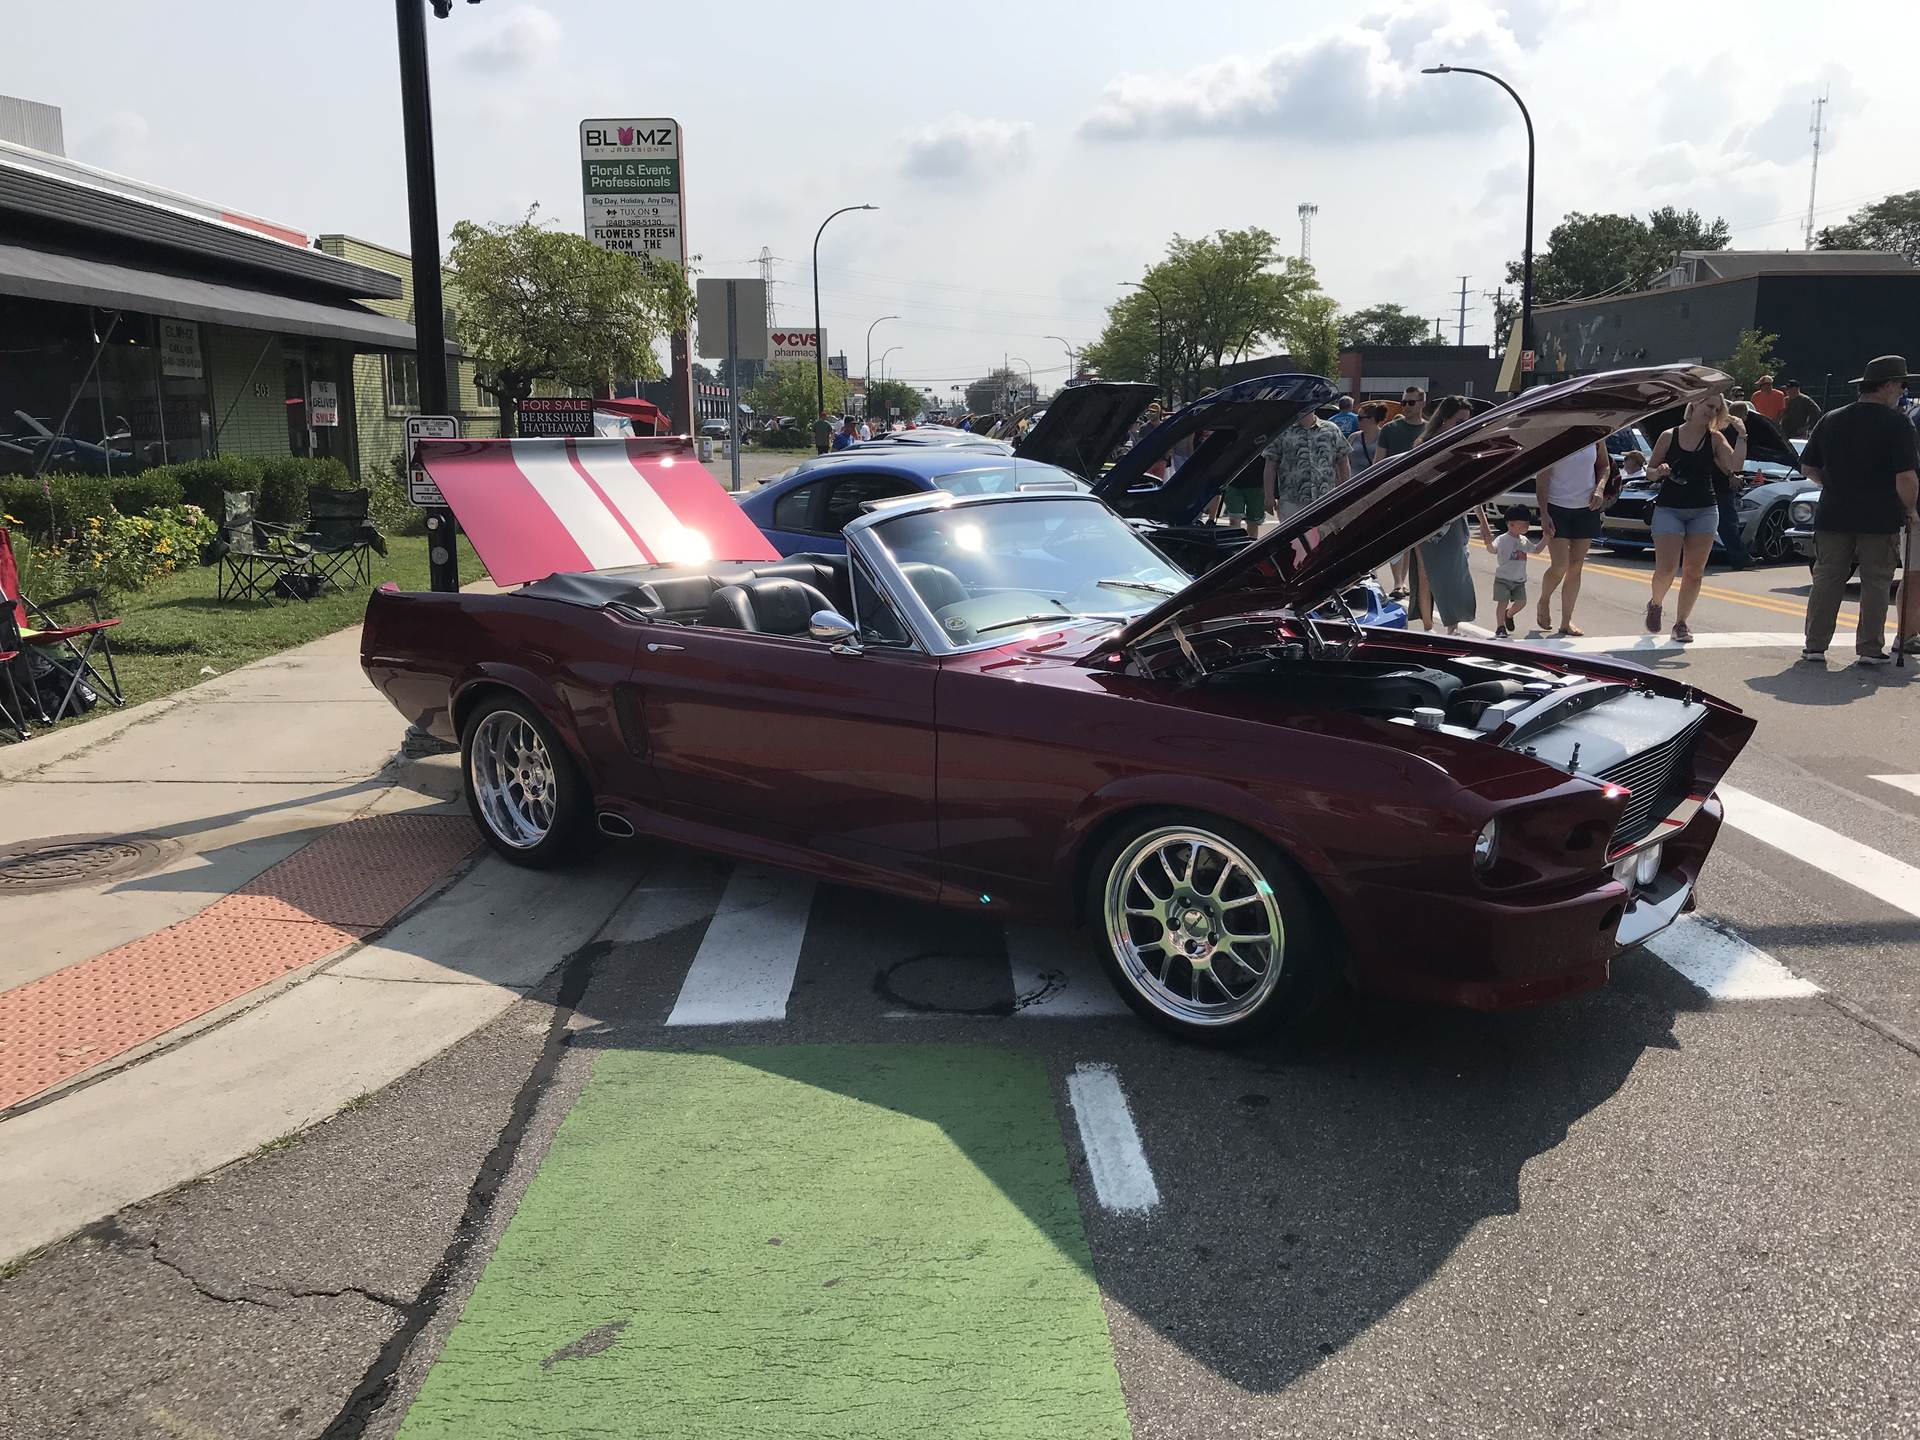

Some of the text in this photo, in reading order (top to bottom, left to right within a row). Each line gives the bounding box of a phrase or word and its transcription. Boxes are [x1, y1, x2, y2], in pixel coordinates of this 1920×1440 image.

[589, 164, 672, 176] Floral & Event
[591, 176, 671, 187] Professionals
[592, 197, 603, 206] Big
[647, 197, 660, 205] Any
[620, 208, 659, 216] TUX ON 9
[594, 228, 675, 239] FLOWERS FRESH
[605, 239, 662, 250] FROM THE
[787, 333, 817, 346] CVS
[774, 348, 818, 359] pharmacy
[255, 383, 270, 397] 503
[522, 400, 589, 411] FOR SALE
[520, 412, 591, 423] BERKSHIRE
[523, 423, 589, 433] HATHAWAY
